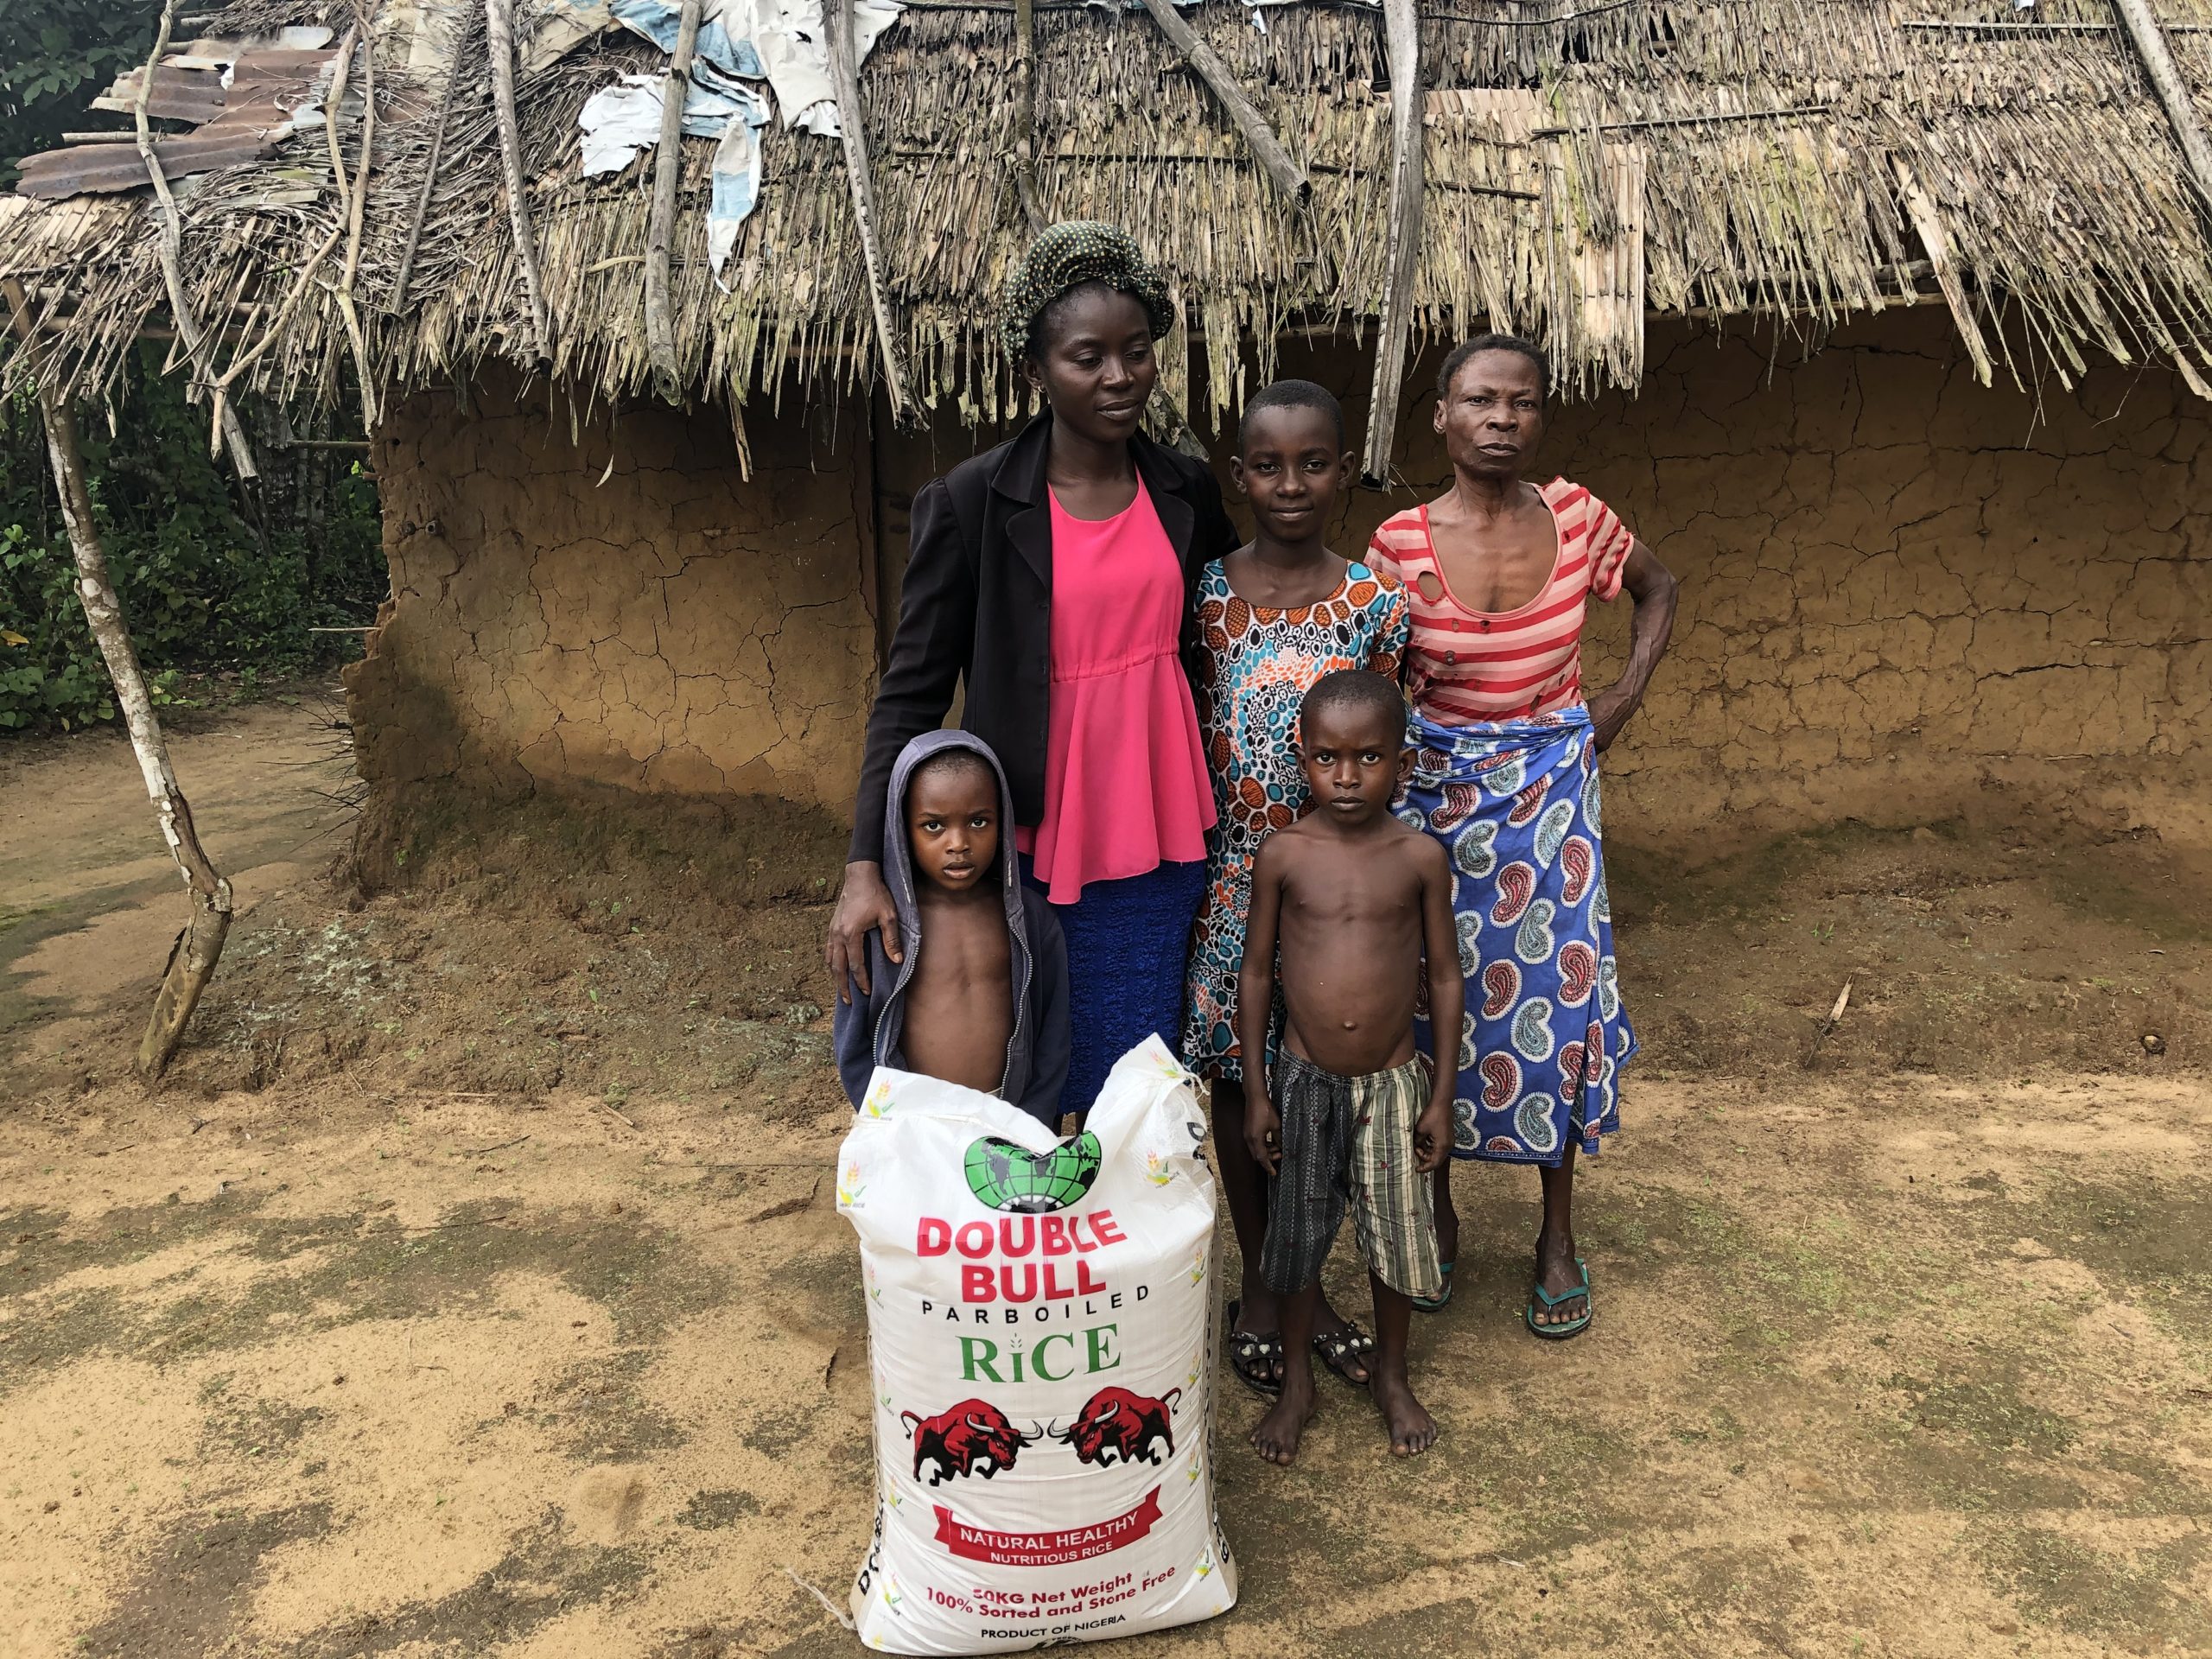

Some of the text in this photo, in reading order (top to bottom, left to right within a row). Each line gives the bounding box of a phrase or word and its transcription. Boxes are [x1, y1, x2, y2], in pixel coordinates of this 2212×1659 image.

[917, 1209, 1128, 1260] DOUBLE
[961, 1260, 1107, 1303] BULL
[922, 1285, 1149, 1325] PARBOILED
[960, 1510, 1139, 1551] NATURAL HEALTHY
[990, 1541, 1113, 1565] NUTRITIOUS RICE
[927, 1567, 1176, 1618] 100% Sorted and Stone Free
[1032, 1592, 1065, 1605] Net
[1071, 1573, 1133, 1599] Weight
[981, 1614, 1127, 1638] PRODUCT OF NIGERIA
